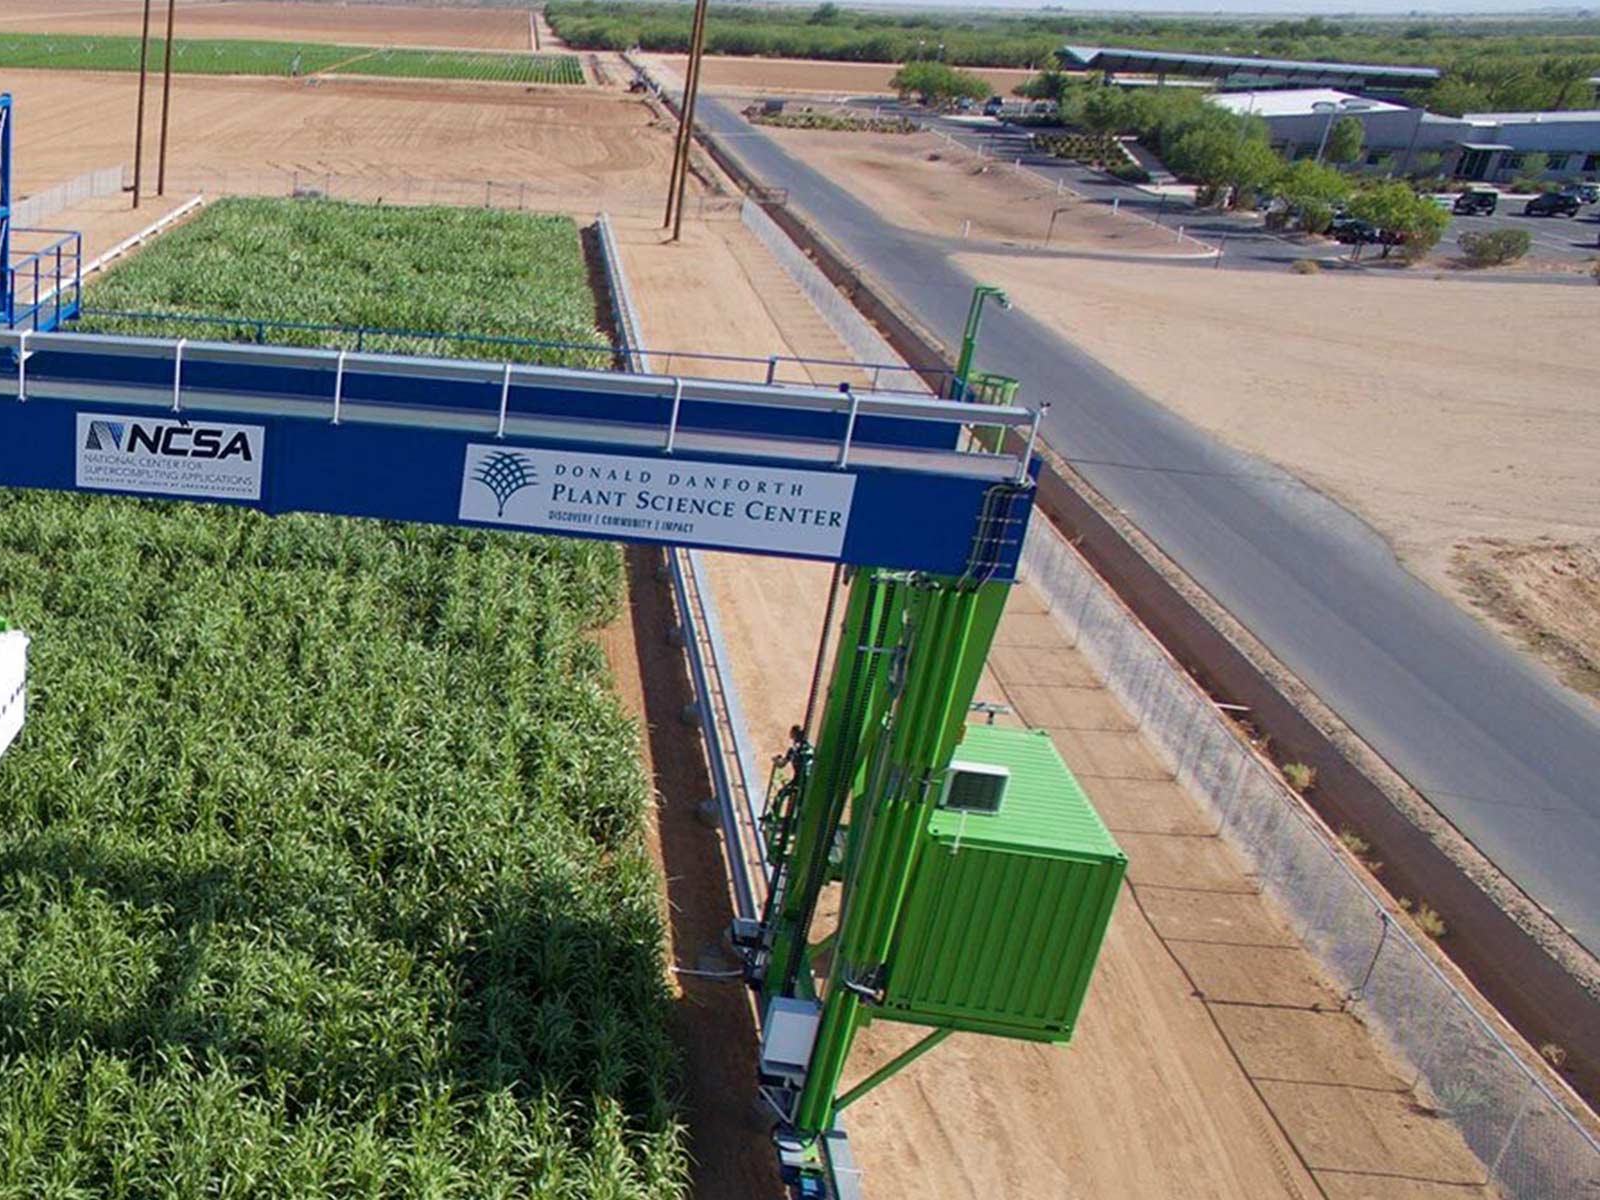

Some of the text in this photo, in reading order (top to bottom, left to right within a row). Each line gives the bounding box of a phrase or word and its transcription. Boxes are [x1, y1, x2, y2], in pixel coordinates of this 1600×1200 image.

[127, 424, 252, 461] NCSA
[84, 454, 202, 471] NATIONAL CENTER FOR
[84, 465, 178, 482] SUPERCOMPUTING
[181, 472, 252, 486] APPLICATIONS
[555, 464, 803, 496] DONALD DANFORTH
[552, 483, 842, 528] PLANT SCIENCE CENTER
[548, 510, 694, 534] DISCOVERY COMMUNITY IMPACT
